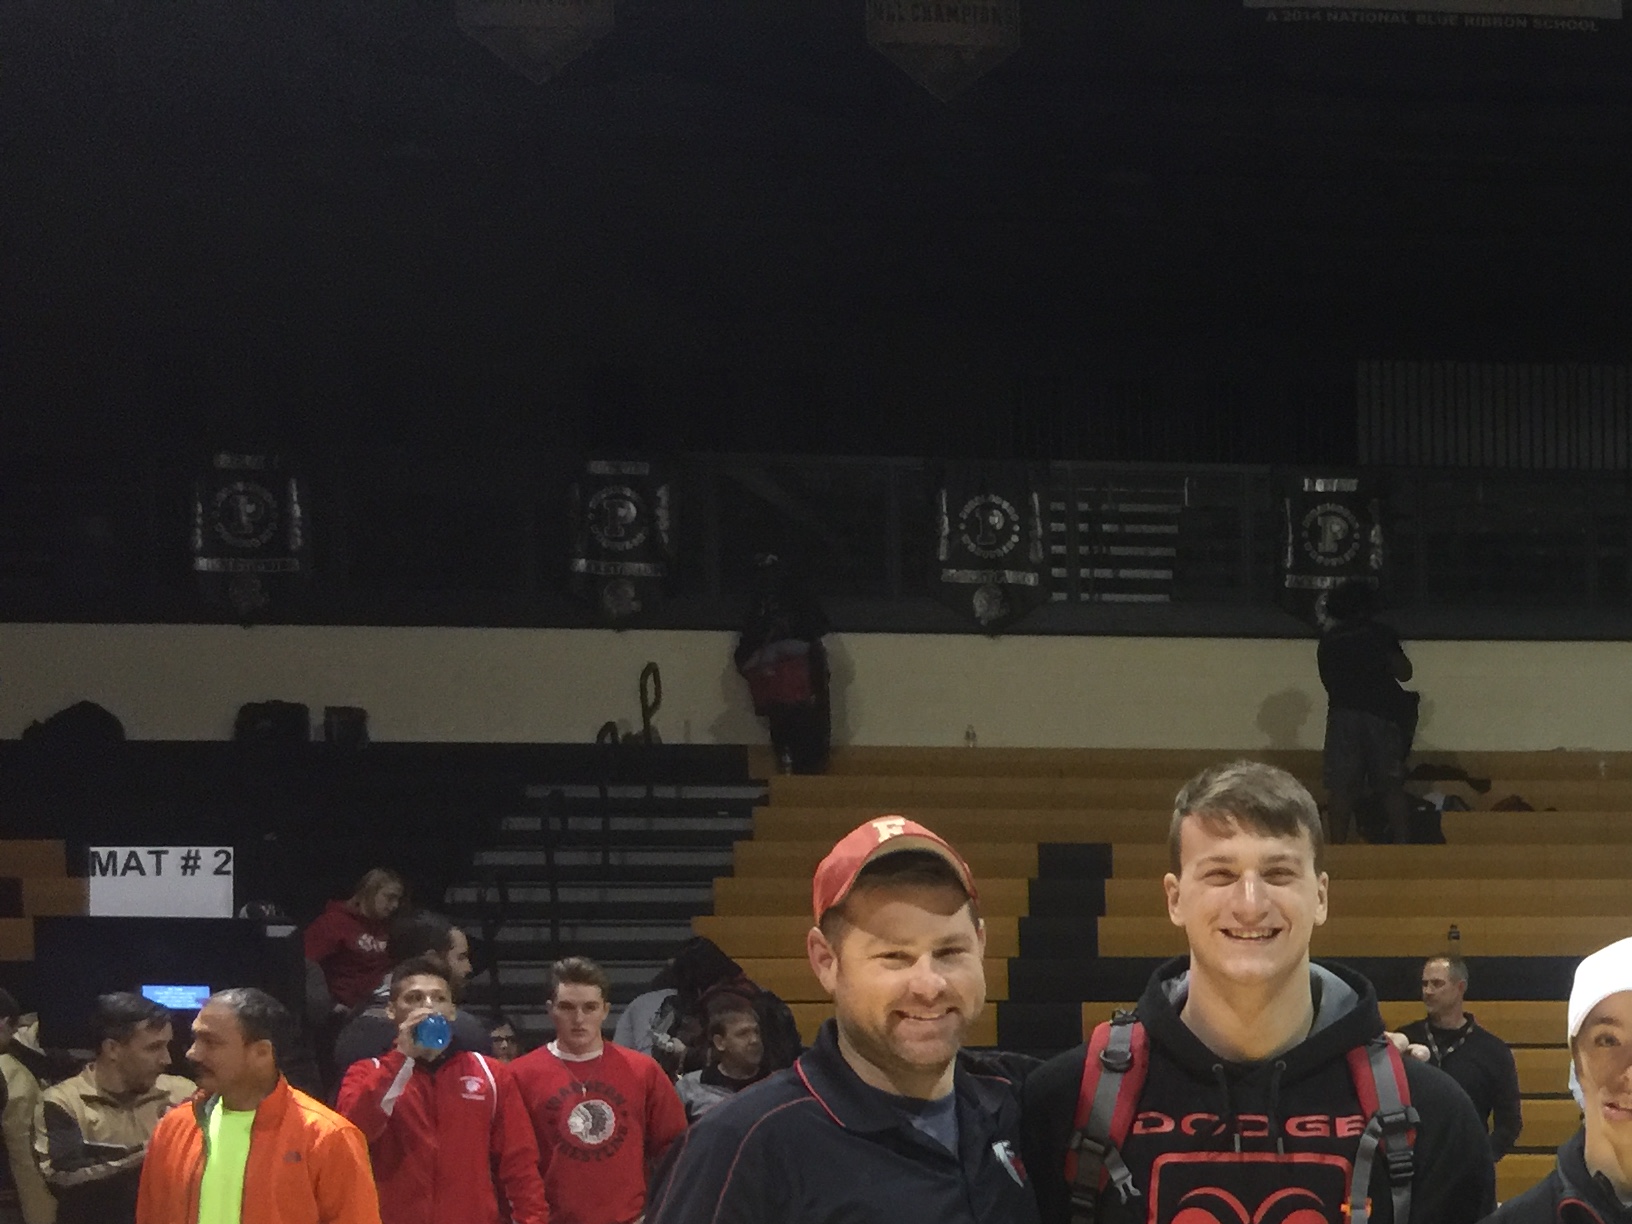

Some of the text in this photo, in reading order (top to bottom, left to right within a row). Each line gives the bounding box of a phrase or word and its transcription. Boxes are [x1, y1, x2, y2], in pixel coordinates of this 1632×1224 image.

[1265, 10, 1600, 32] A 2014 NATIONAL BLUE RIBBON SCHOOL
[872, 819, 906, 843] F
[89, 849, 233, 877] MAT # 2
[1132, 1110, 1368, 1138] DODGE
